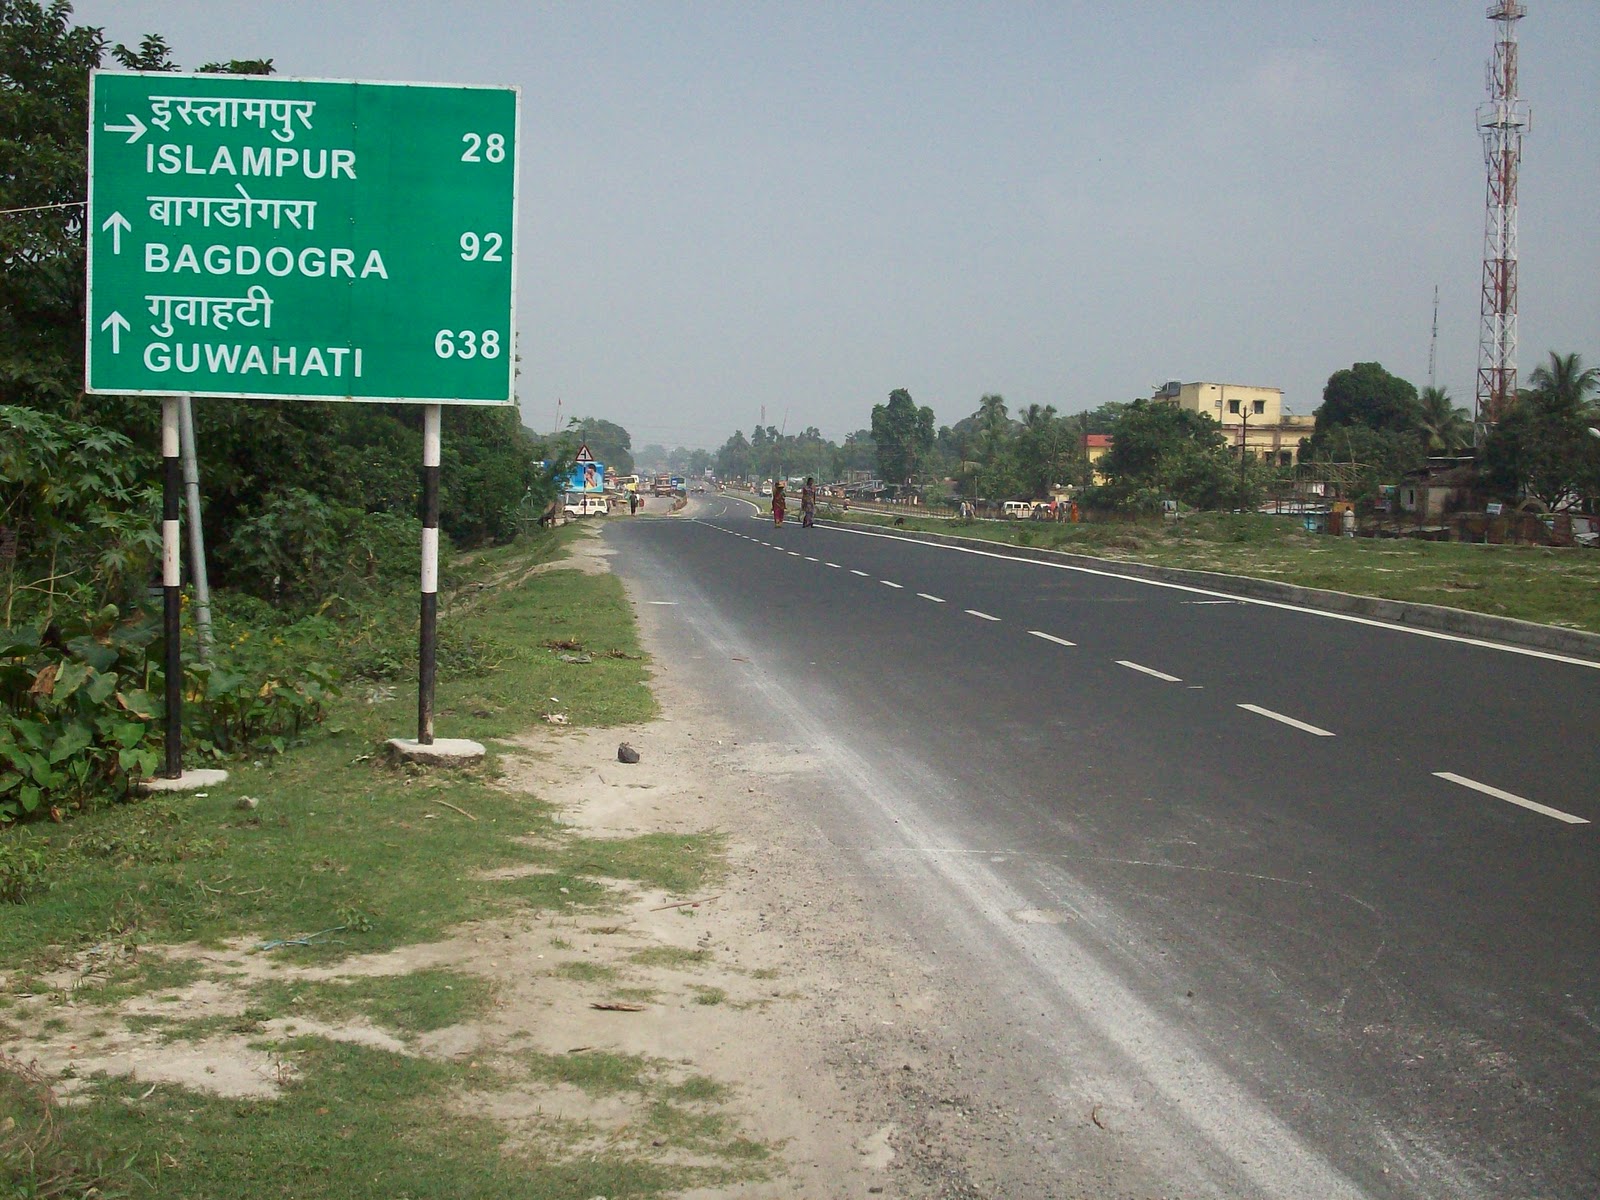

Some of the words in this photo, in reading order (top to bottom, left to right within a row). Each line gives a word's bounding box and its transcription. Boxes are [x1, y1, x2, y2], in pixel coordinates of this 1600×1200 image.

[148, 95, 316, 142] इस्लामपुर
[146, 143, 357, 180] ISLAMPUR
[461, 132, 506, 163] 28
[146, 183, 317, 230] बागडोगरा
[145, 243, 389, 279] BAGDOGRA
[460, 231, 503, 262] 92
[144, 285, 274, 337] गुवाहटी
[143, 342, 363, 377] GUWAHATI
[434, 329, 500, 359] 638
